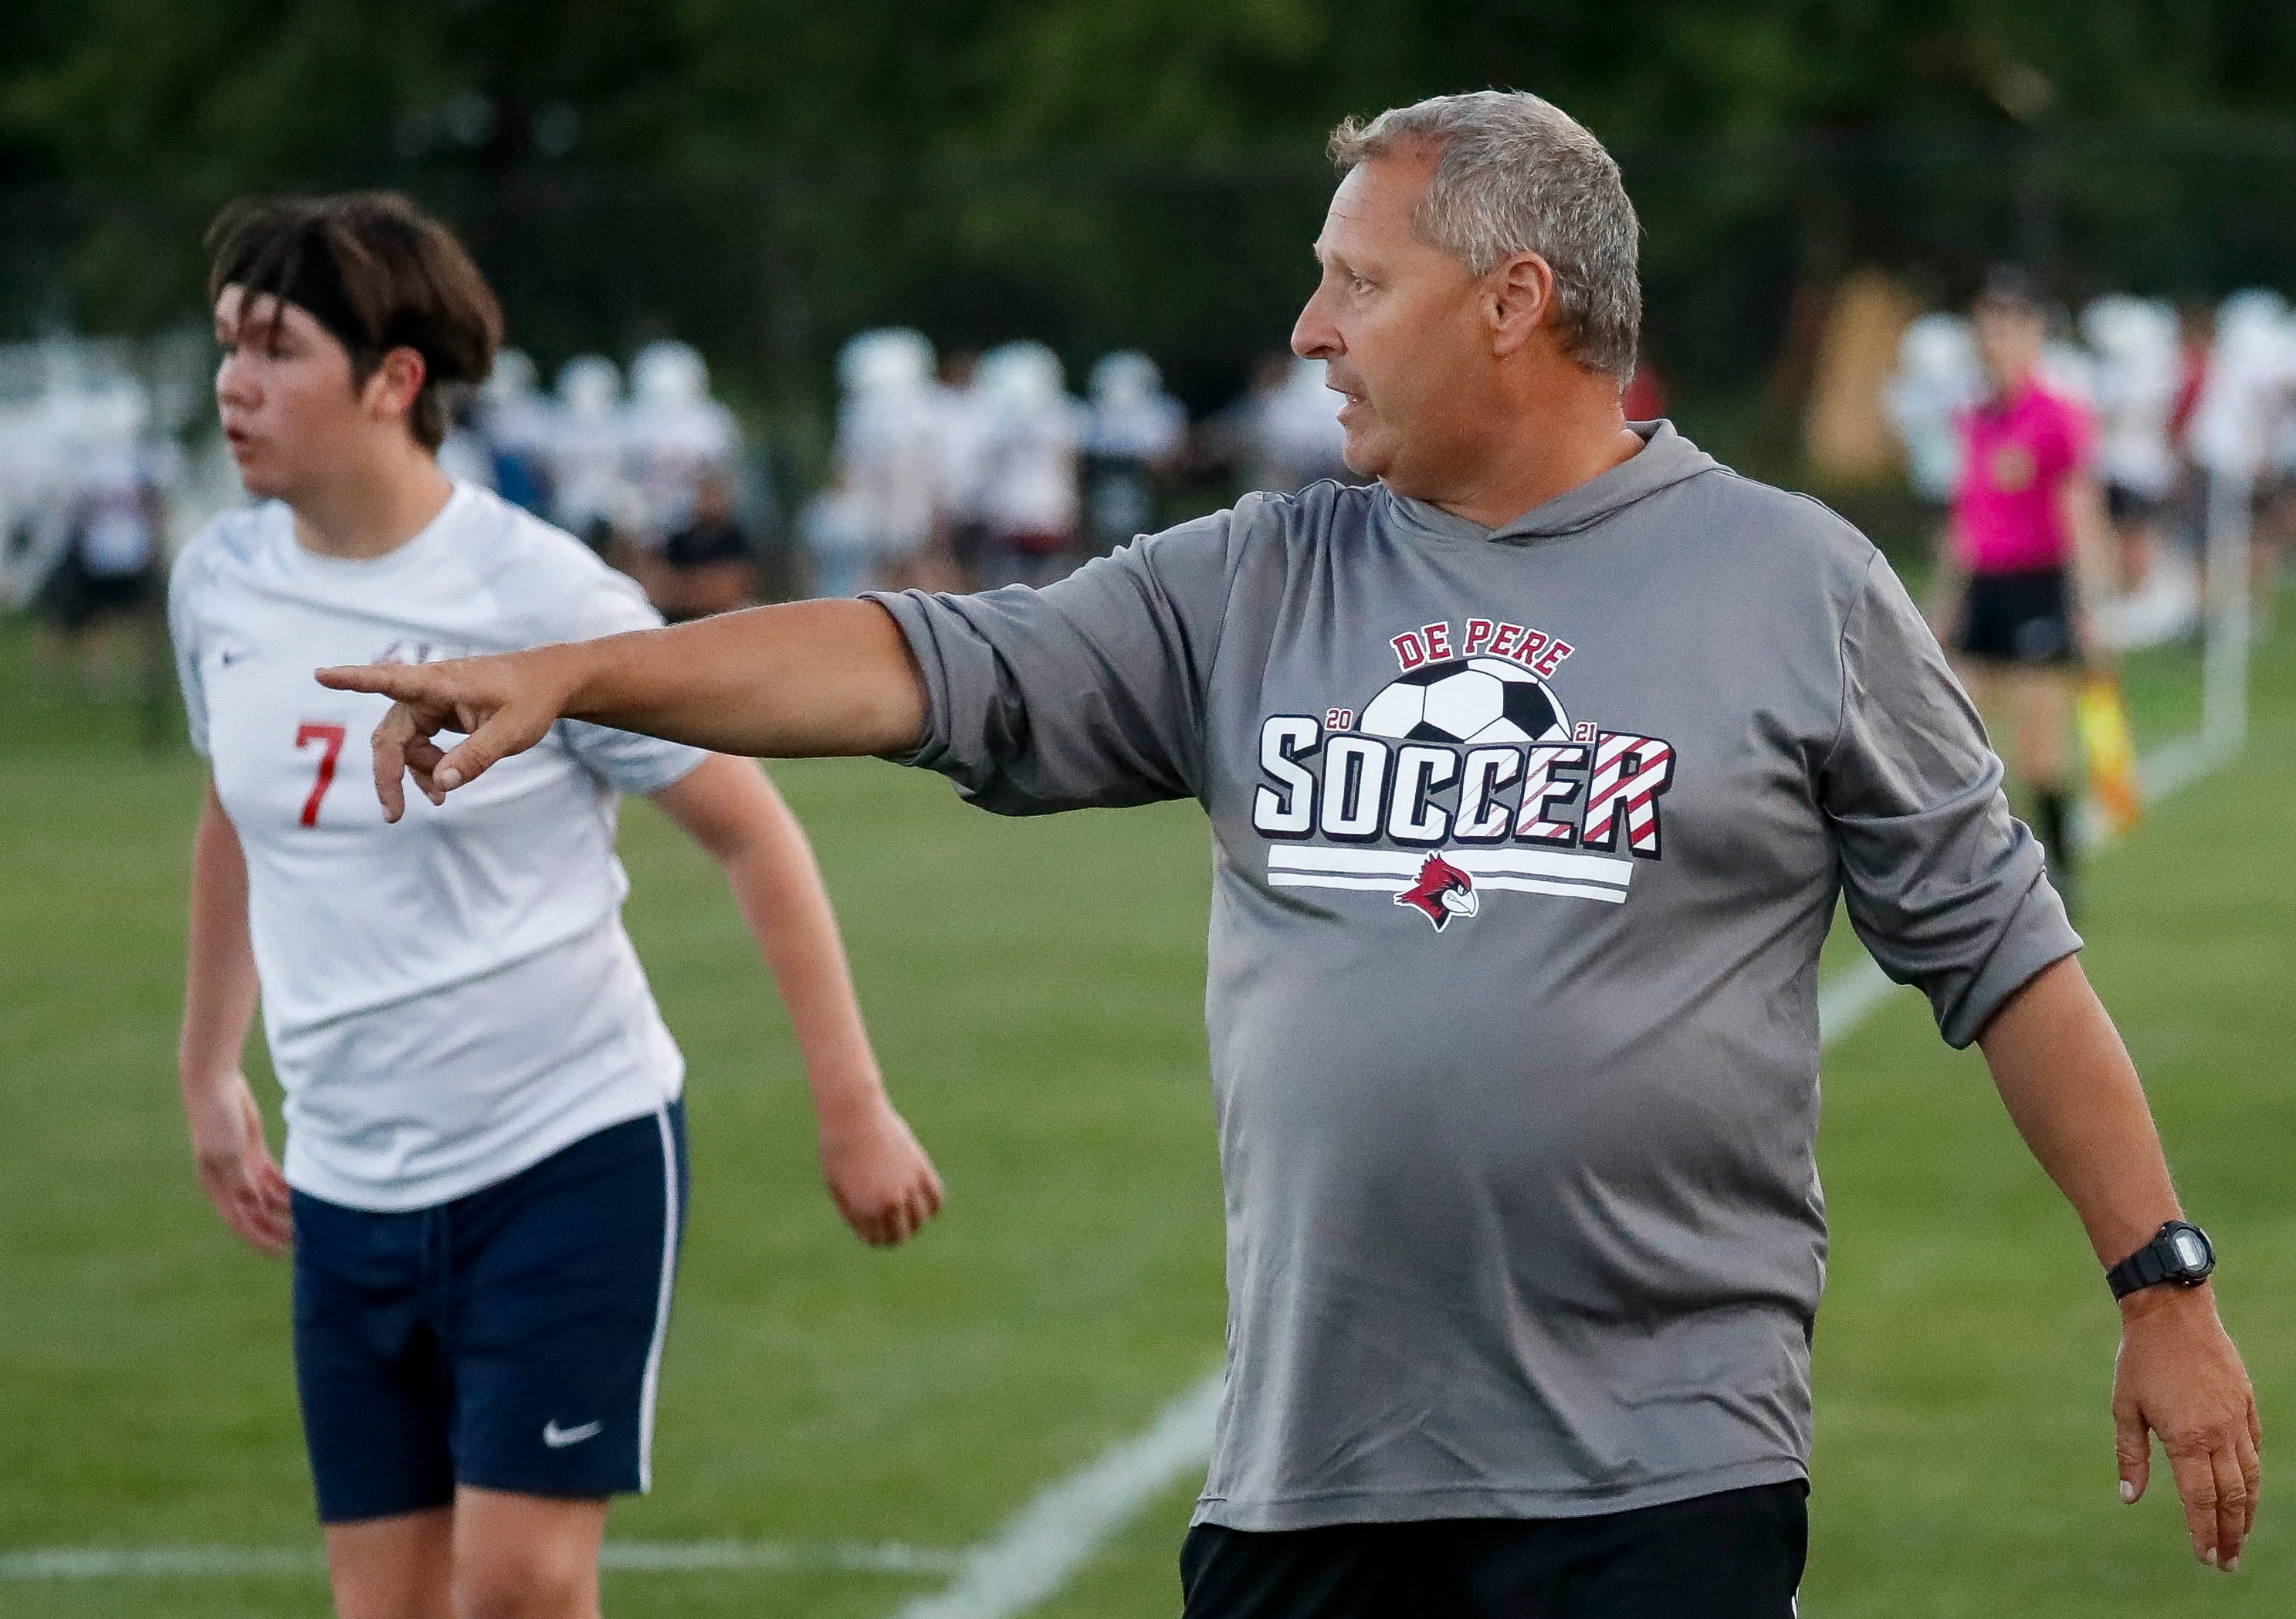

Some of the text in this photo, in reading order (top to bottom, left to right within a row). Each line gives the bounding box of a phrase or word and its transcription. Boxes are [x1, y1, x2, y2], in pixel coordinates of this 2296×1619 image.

[1390, 618, 1575, 679] DE PERE
[1325, 708, 1353, 731] 20
[1573, 723, 1598, 743] 21
[295, 722, 345, 828] 7
[1252, 714, 1677, 861] SOCCER
